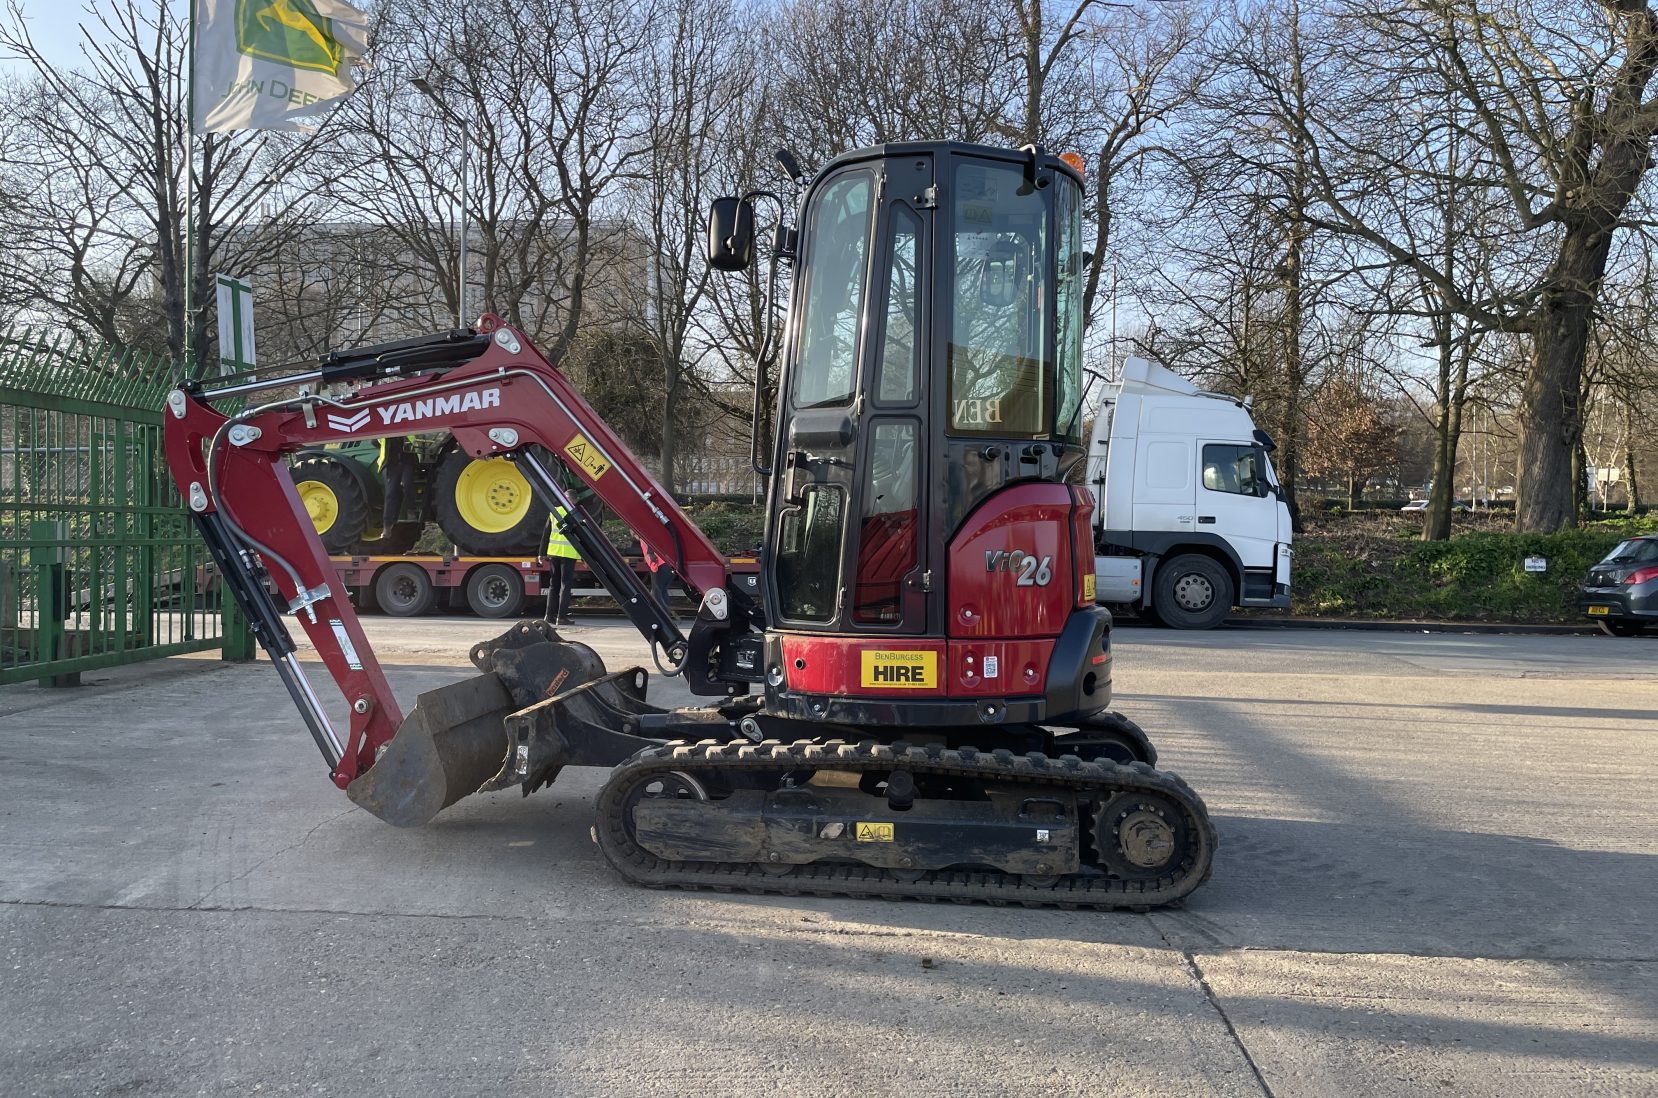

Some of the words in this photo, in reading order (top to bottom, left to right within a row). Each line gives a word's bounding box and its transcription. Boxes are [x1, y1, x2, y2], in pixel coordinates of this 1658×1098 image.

[270, 80, 328, 105] DEE
[377, 388, 500, 425] YANMAR
[1017, 555, 1052, 587] 26
[873, 665, 925, 682] HIRE
